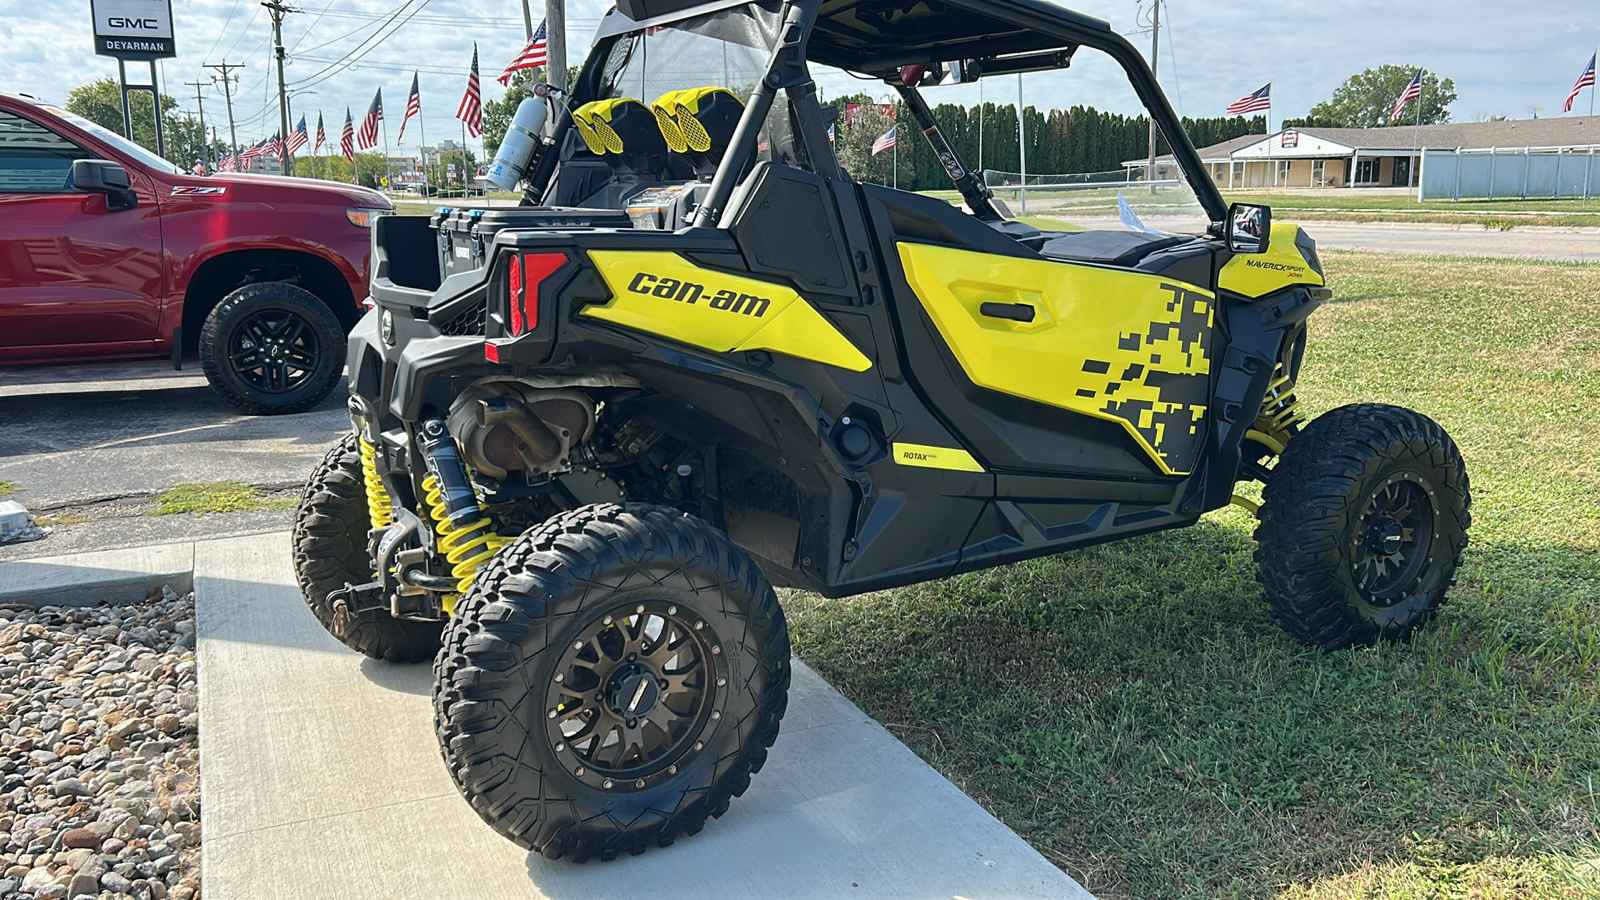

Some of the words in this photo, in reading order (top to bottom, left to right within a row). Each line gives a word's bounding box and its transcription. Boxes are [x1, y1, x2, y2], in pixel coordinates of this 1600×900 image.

[108, 18, 158, 29] GMC
[106, 41, 164, 51] DEYARMAN
[170, 186, 227, 196] Z71
[904, 452, 927, 460] ROTAX
